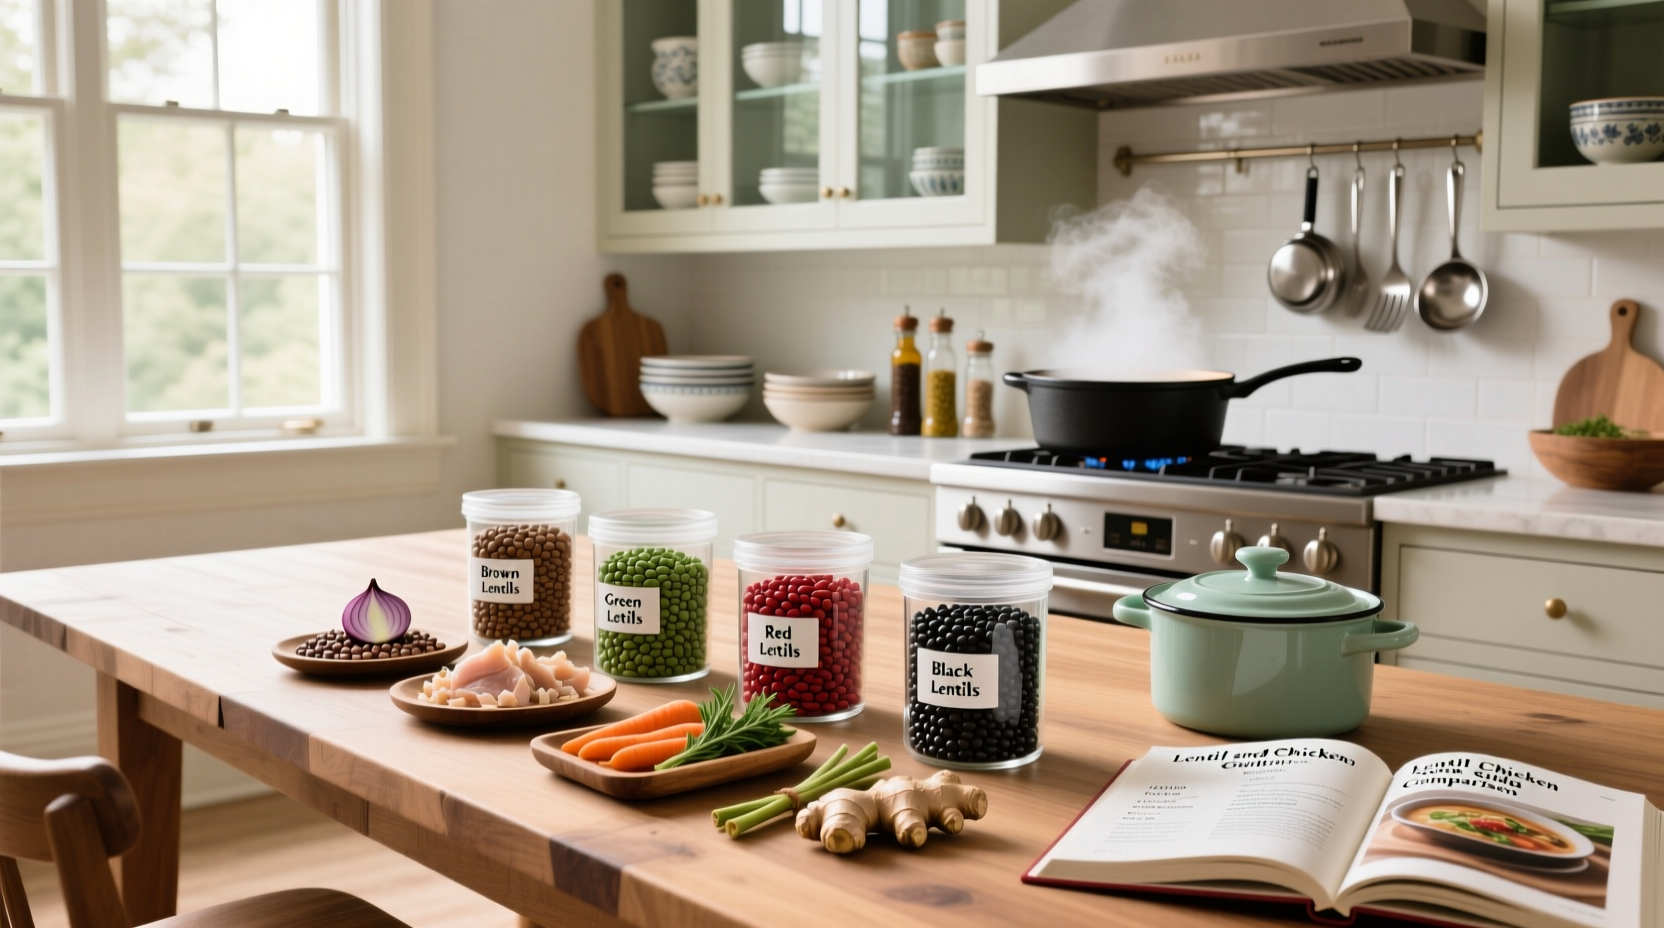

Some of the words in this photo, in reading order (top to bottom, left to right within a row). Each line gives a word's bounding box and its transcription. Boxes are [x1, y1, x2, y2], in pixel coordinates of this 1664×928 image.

[481, 565, 520, 579] Brown
[604, 593, 642, 608] Green
[765, 625, 792, 640] Red
[932, 661, 974, 678] Black
[931, 680, 980, 697] Lentils
[1173, 750, 1229, 763] Lentil
[1274, 747, 1356, 767] Chicken
[1478, 761, 1559, 792] Chicken
